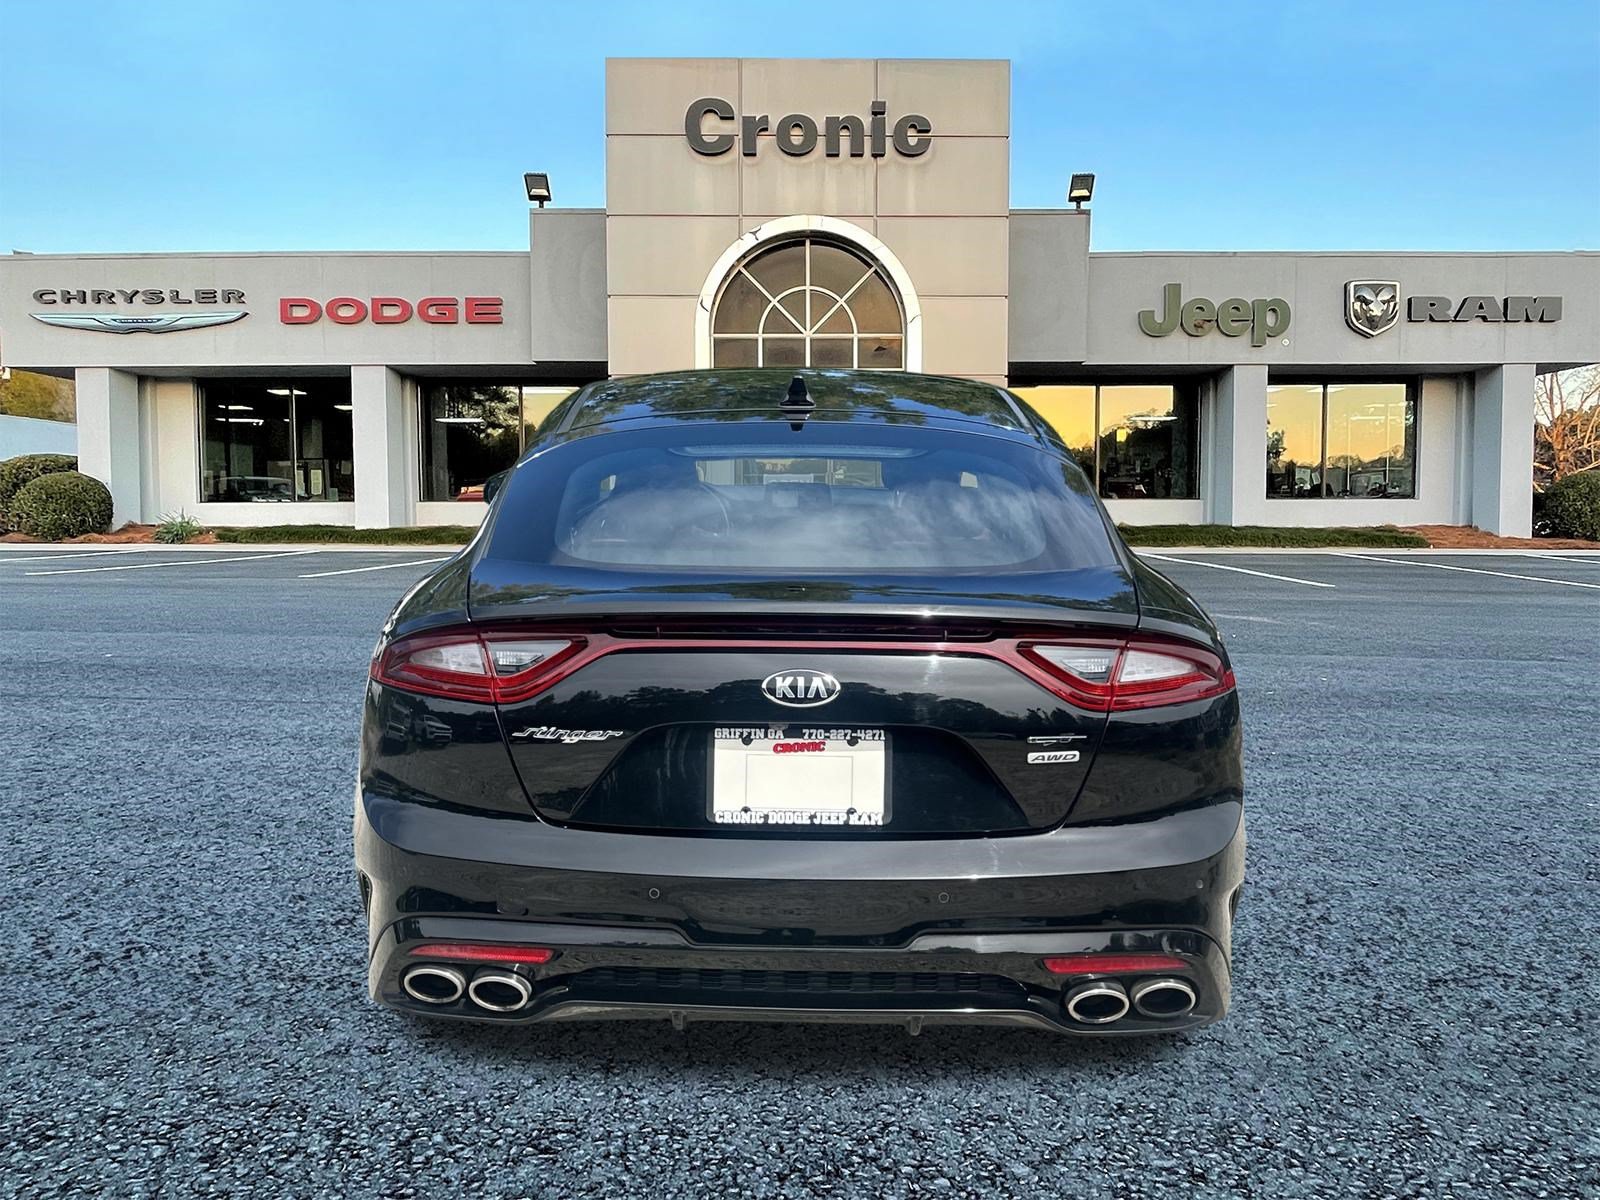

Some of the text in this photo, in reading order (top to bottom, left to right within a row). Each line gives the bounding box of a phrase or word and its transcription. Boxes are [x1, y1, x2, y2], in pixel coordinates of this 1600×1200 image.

[685, 97, 933, 158] Cronic
[32, 288, 246, 304] CHRYSLER
[280, 297, 504, 325] DODGE
[1139, 283, 1292, 347] Jeep
[1407, 296, 1563, 323] RAM
[774, 676, 829, 699] KIA
[714, 727, 785, 740] GRIFFIN GA
[802, 728, 886, 741] 770-227-4271
[772, 741, 826, 754] CRONIC
[1030, 753, 1077, 762] AWD
[714, 810, 884, 826] CRONIC DODGE JEEP RAM
